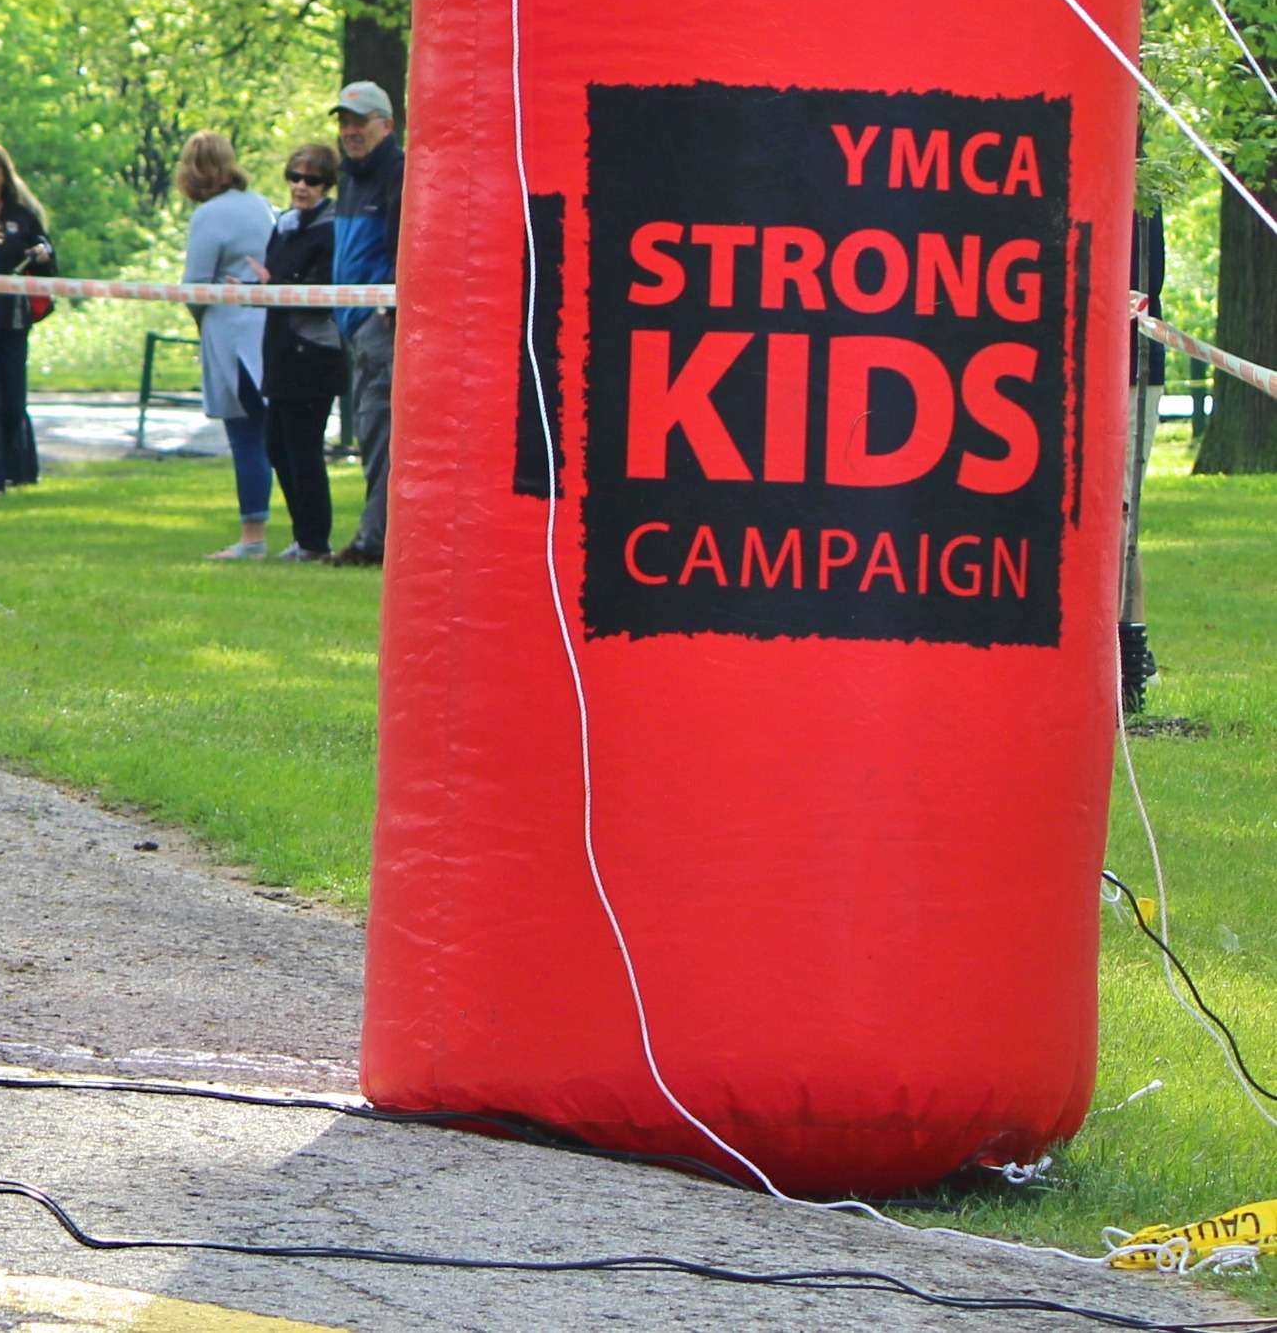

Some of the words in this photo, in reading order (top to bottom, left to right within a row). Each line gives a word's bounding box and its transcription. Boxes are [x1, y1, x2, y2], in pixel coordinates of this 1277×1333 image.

[831, 124, 1043, 197] YMCA
[627, 221, 1043, 322] STRONG
[625, 330, 1041, 494] KIDS
[623, 522, 1029, 599] CAMPAIGN
